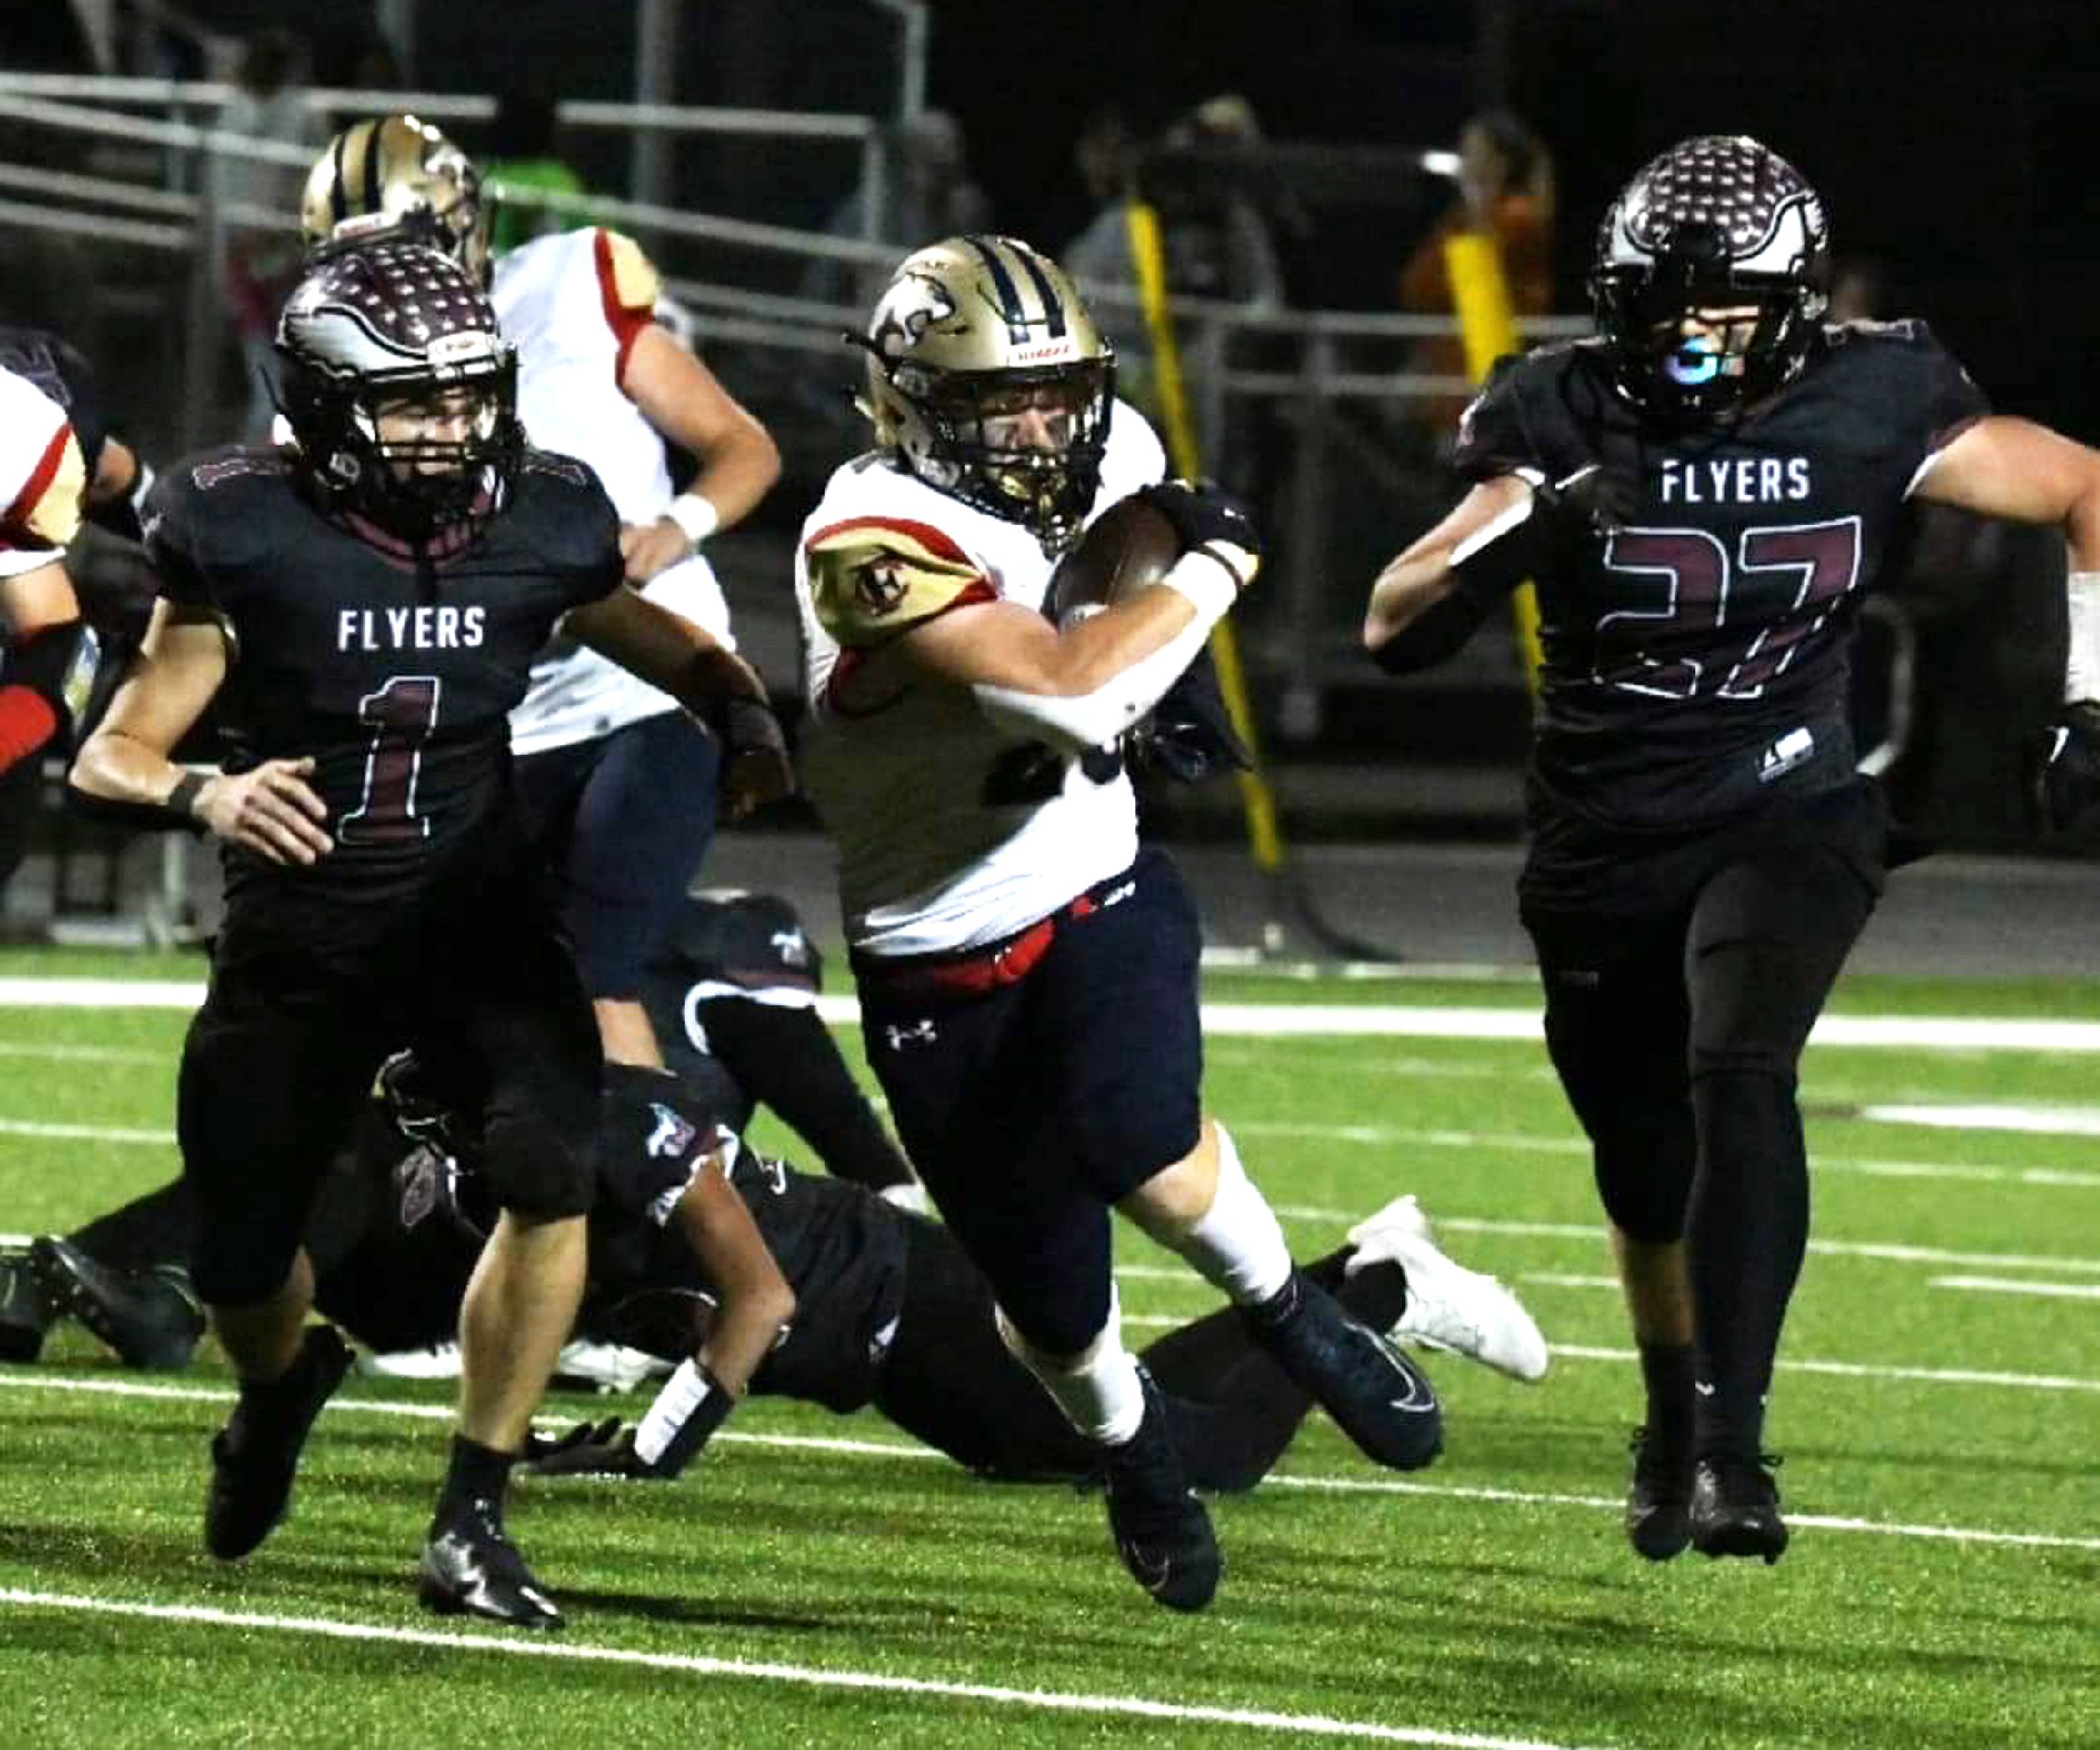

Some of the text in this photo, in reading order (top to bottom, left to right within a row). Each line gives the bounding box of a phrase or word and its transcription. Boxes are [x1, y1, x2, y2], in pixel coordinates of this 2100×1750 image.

[1662, 458, 1811, 501] FLYERS
[337, 606, 486, 651] FLYERS
[1594, 515, 1861, 699] 27
[337, 675, 441, 845] 1
